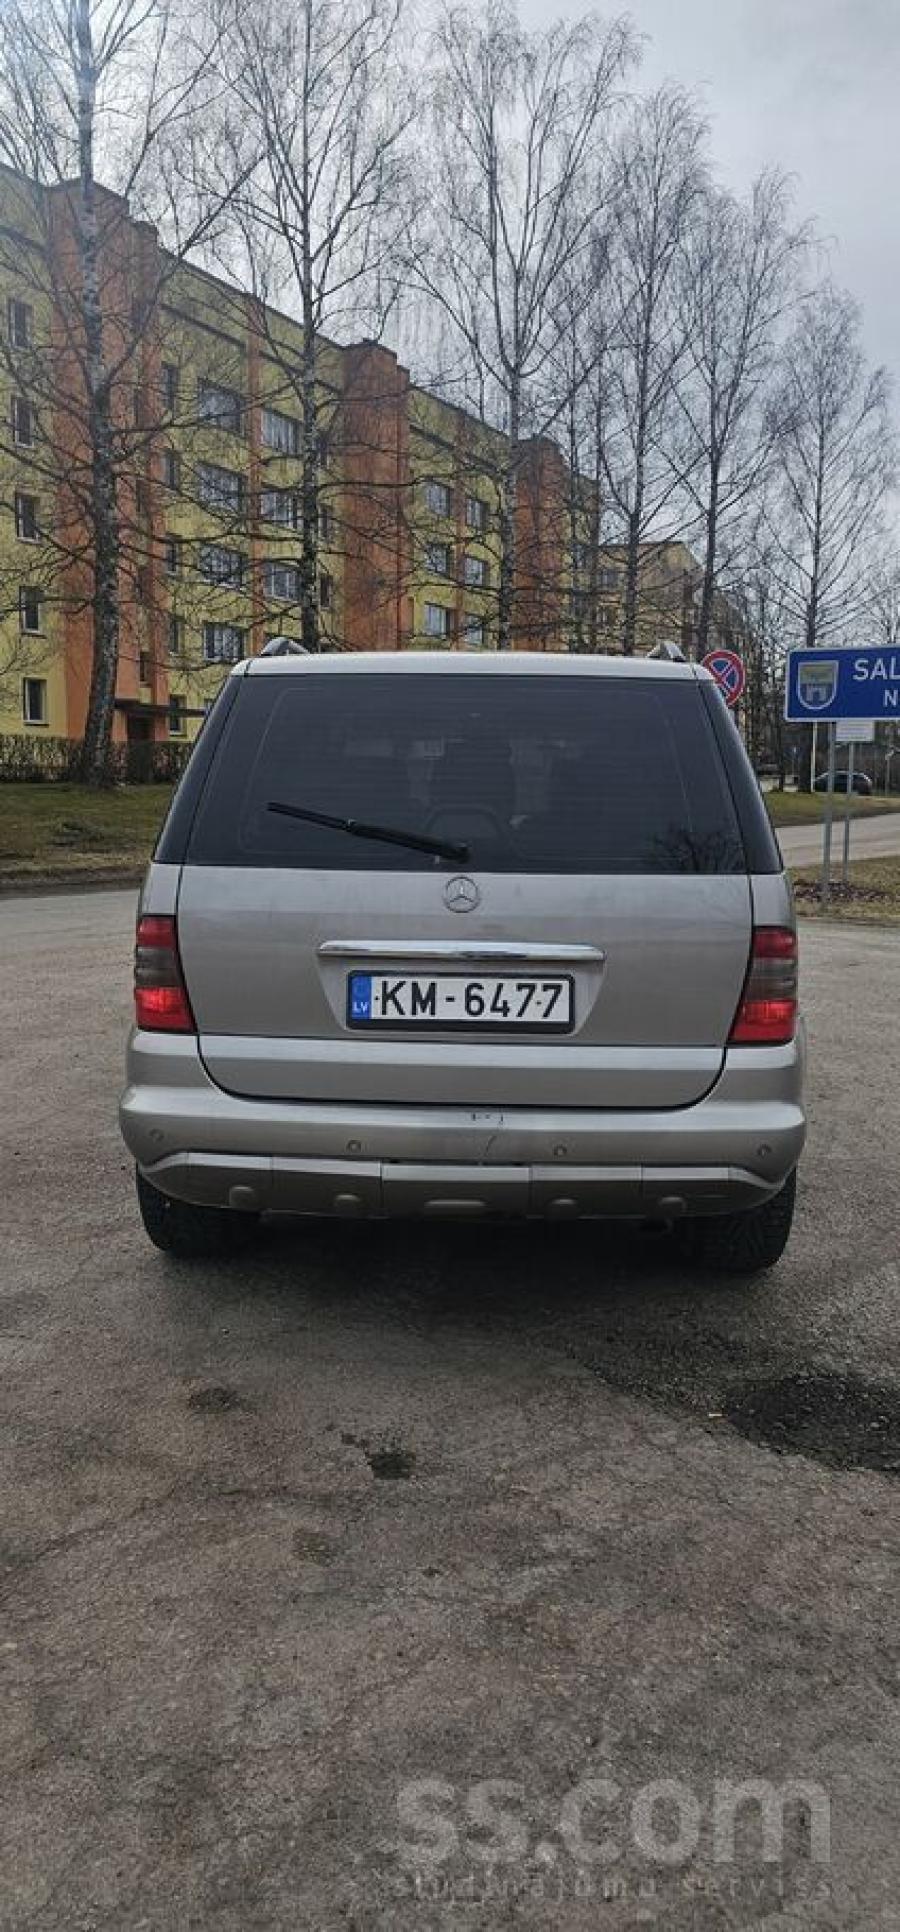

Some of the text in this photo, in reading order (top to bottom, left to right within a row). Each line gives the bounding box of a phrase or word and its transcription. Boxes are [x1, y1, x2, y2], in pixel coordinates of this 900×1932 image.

[853, 656, 900, 680] SAL
[353, 981, 562, 1017] LV KM-6477
